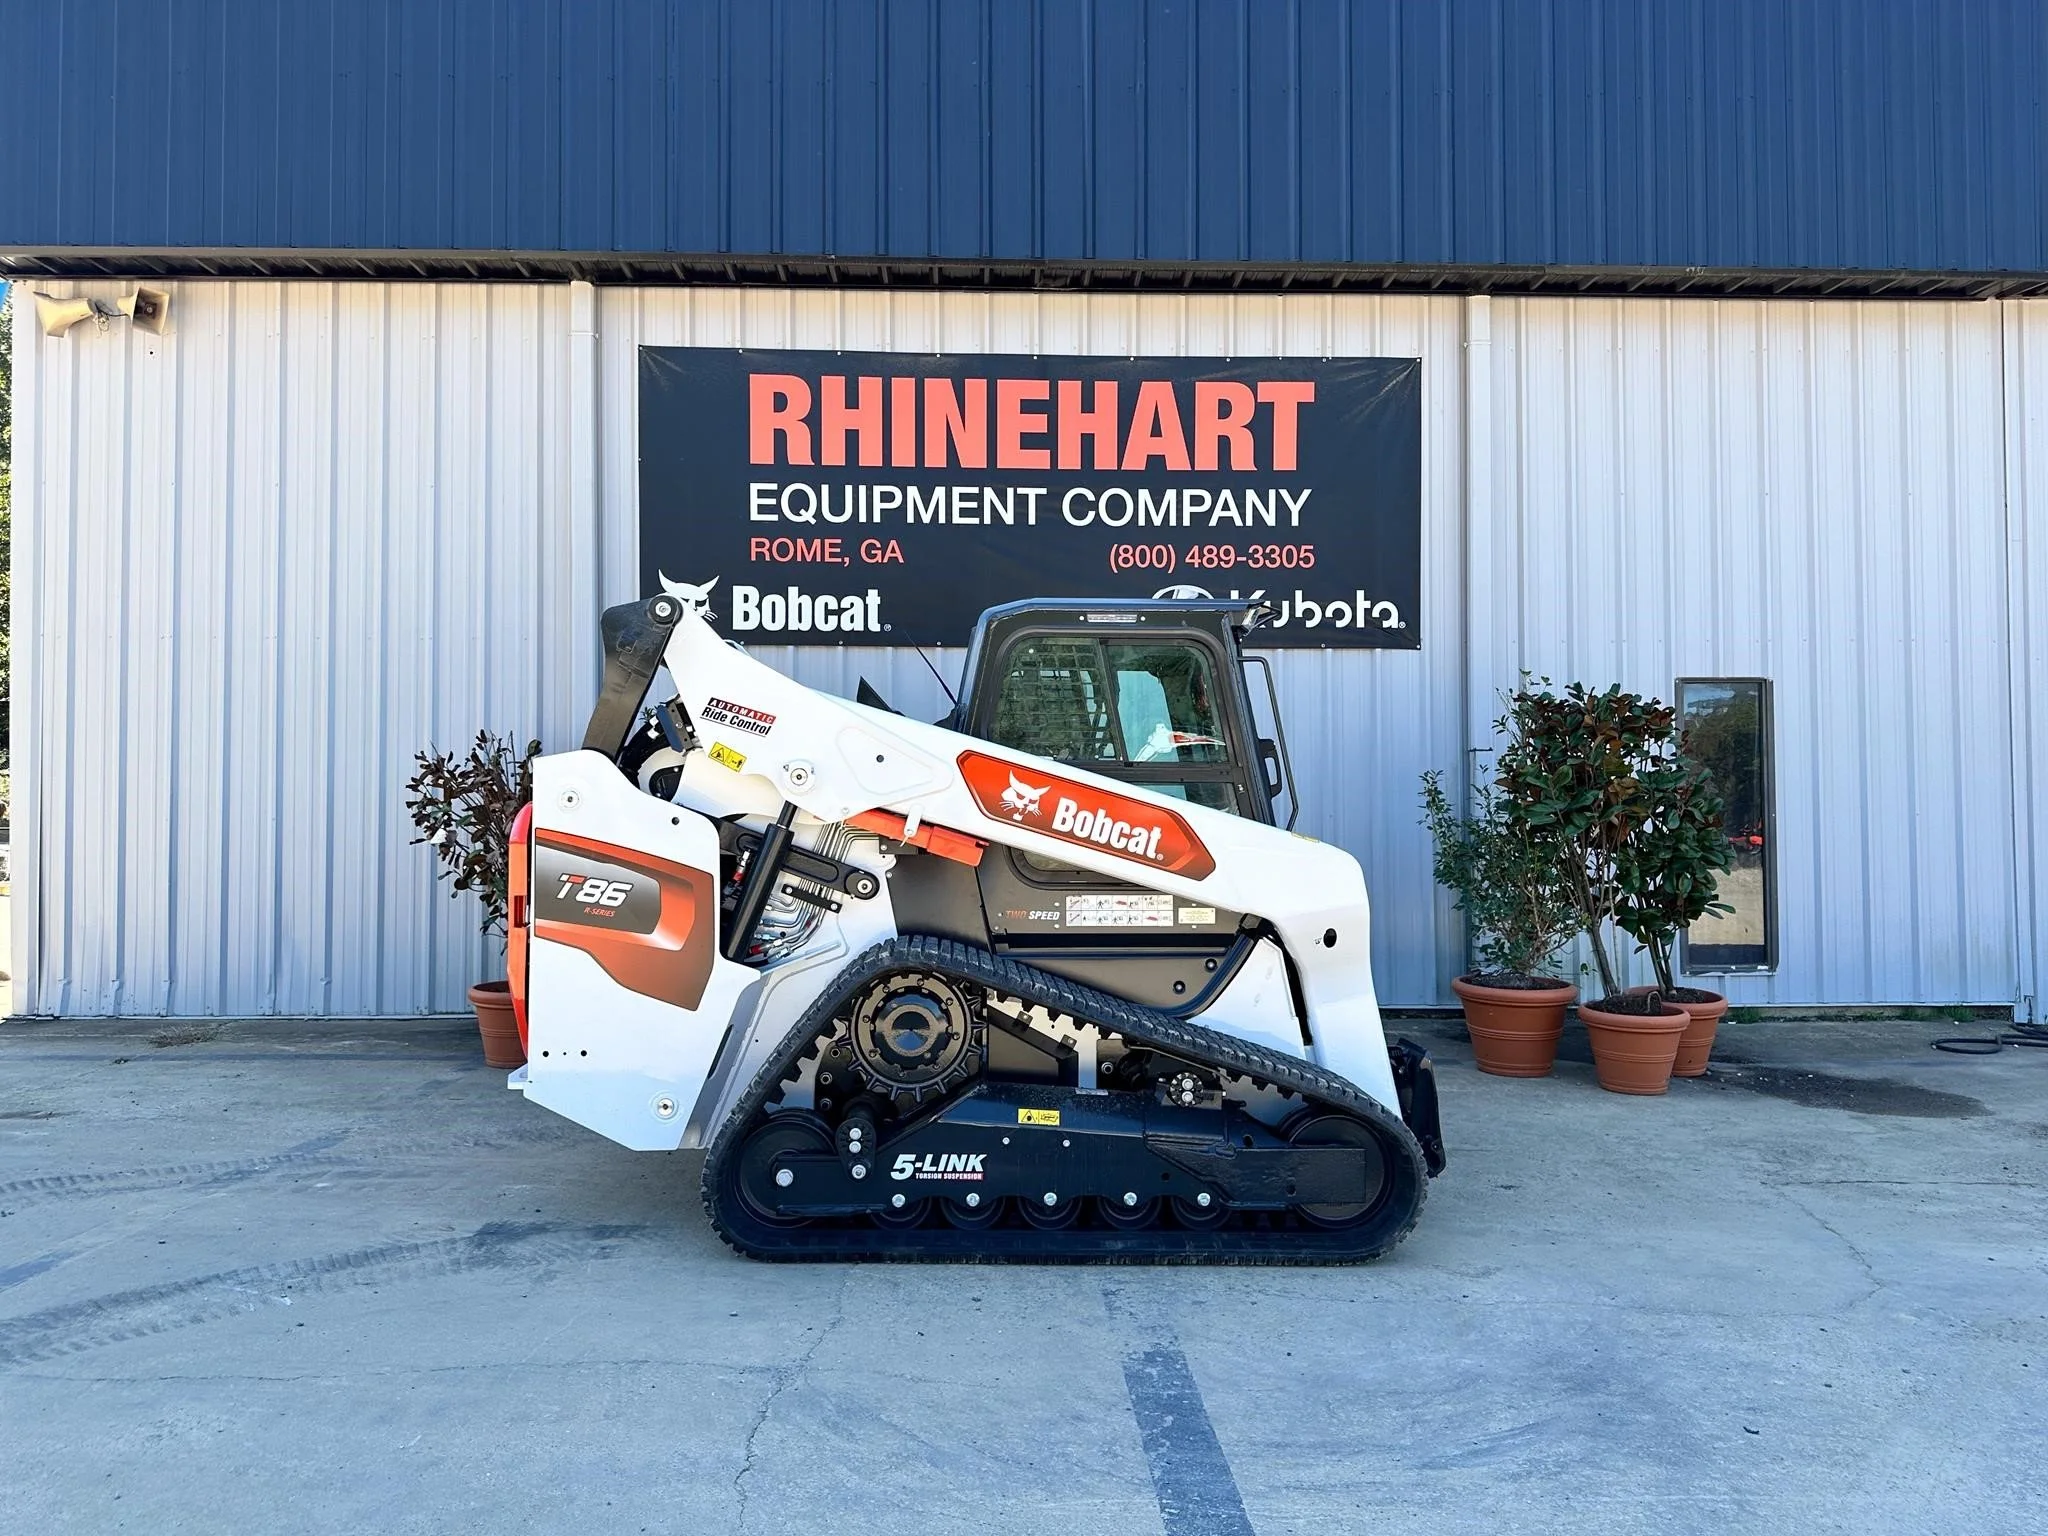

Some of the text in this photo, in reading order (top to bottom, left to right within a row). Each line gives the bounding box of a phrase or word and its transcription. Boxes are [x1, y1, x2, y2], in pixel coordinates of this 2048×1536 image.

[749, 373, 1315, 472] RHINEHART
[749, 482, 1312, 527] EQUIPMENT COMPANY
[750, 537, 905, 567] ROME, GA
[1109, 543, 1315, 573] (800) 489-3305
[732, 585, 881, 632] Bobcat
[701, 706, 772, 736] Ride Control
[710, 699, 774, 723] AUTOMATIC
[1051, 796, 1162, 860] Bobcat
[556, 873, 634, 907] T86
[583, 907, 616, 918] R-SERIES
[1005, 910, 1060, 920] TWO SPEED
[890, 1153, 987, 1180] 5-LINK
[915, 1172, 984, 1180] TORSION SUSPENSION
